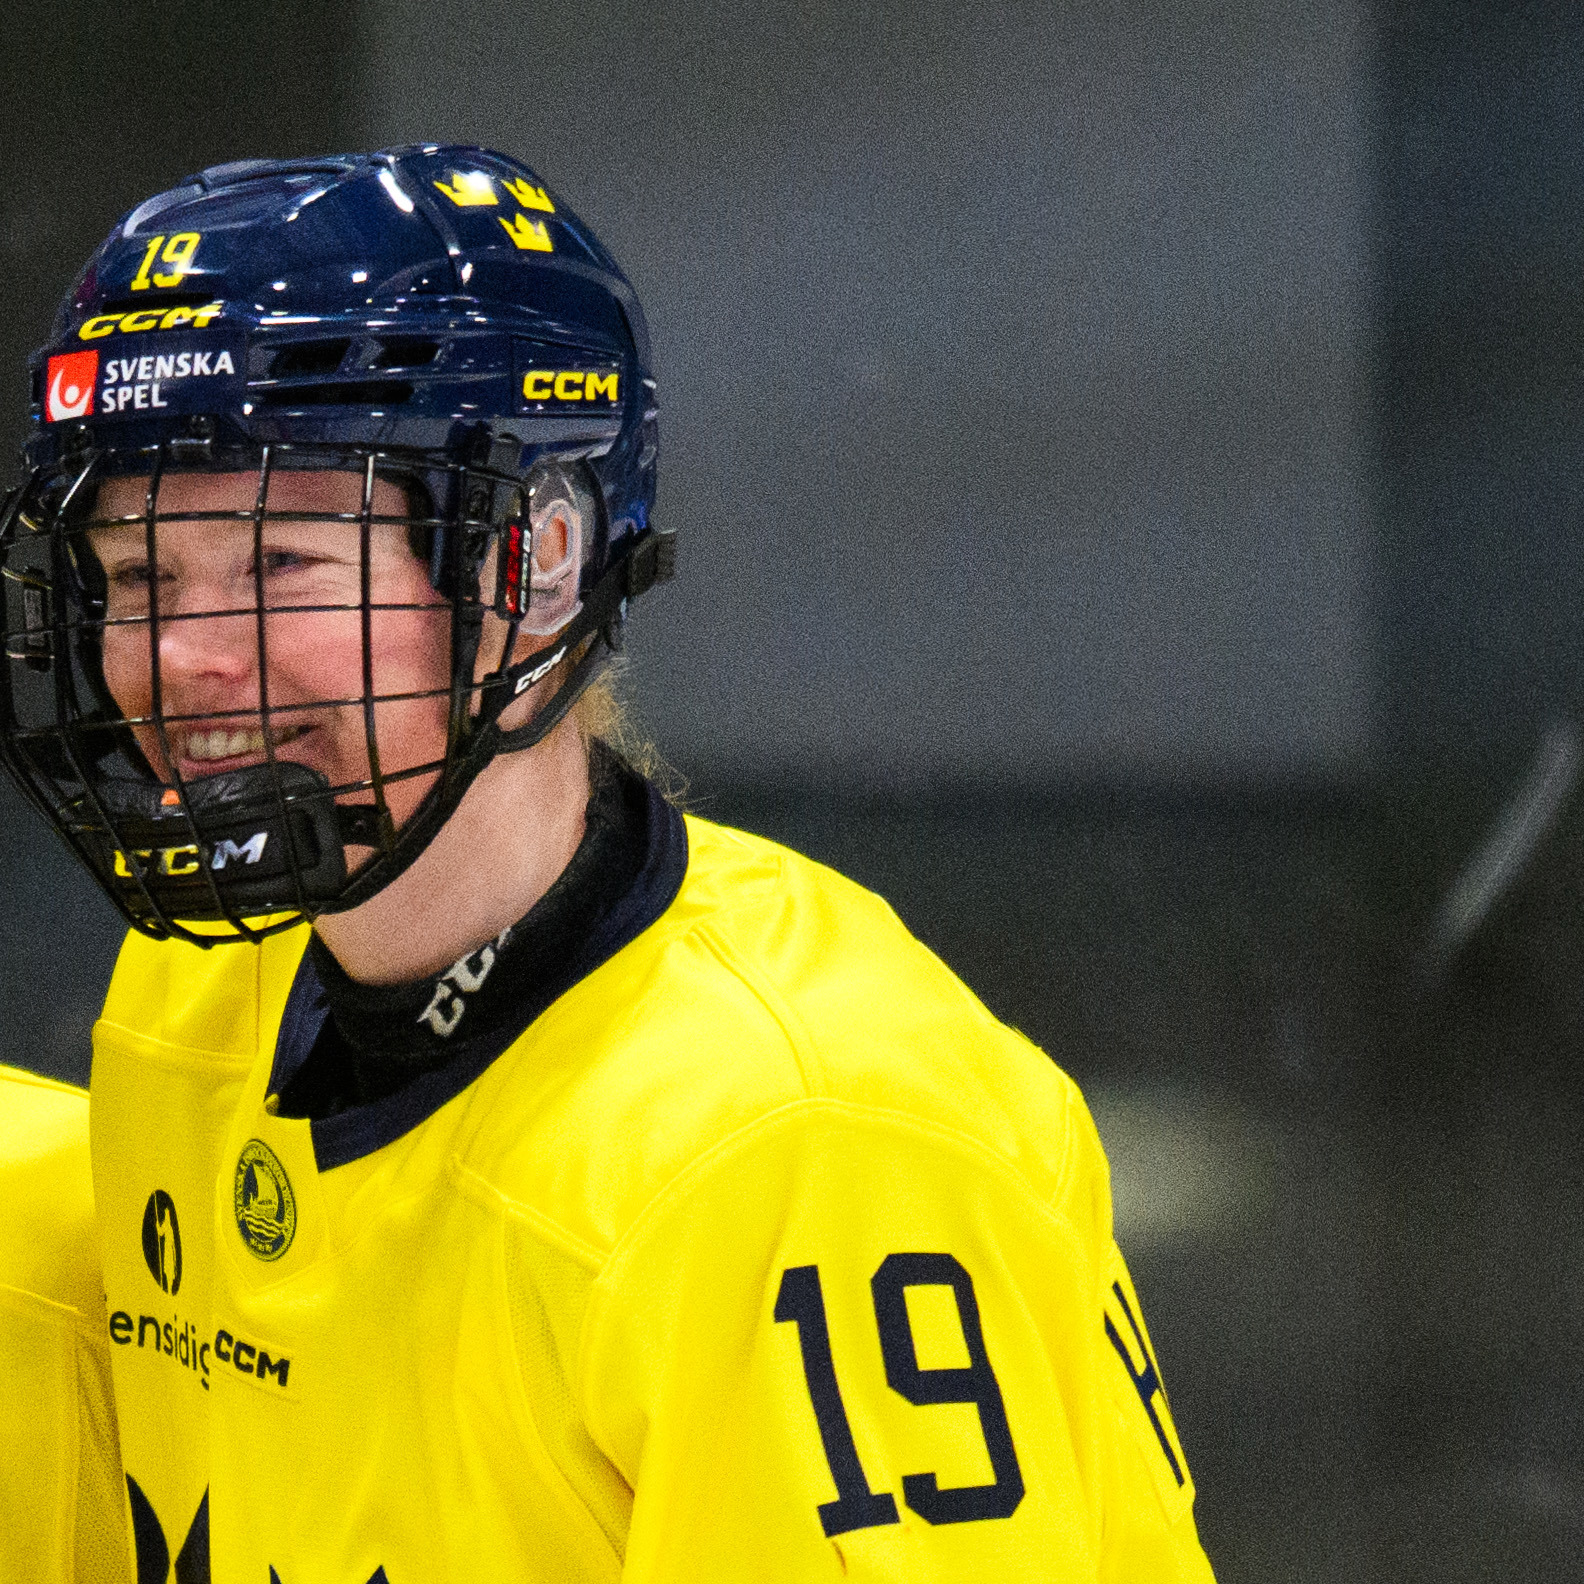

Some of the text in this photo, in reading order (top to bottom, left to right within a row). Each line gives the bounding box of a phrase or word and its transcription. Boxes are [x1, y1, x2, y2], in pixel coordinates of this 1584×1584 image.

[131, 232, 202, 291] 19
[78, 303, 223, 341] CCM
[103, 351, 235, 382] SVENSKA
[101, 383, 168, 413] SPEL
[522, 370, 619, 402] CCM
[214, 1329, 292, 1388] CCM
[773, 1252, 1026, 1539] 19
